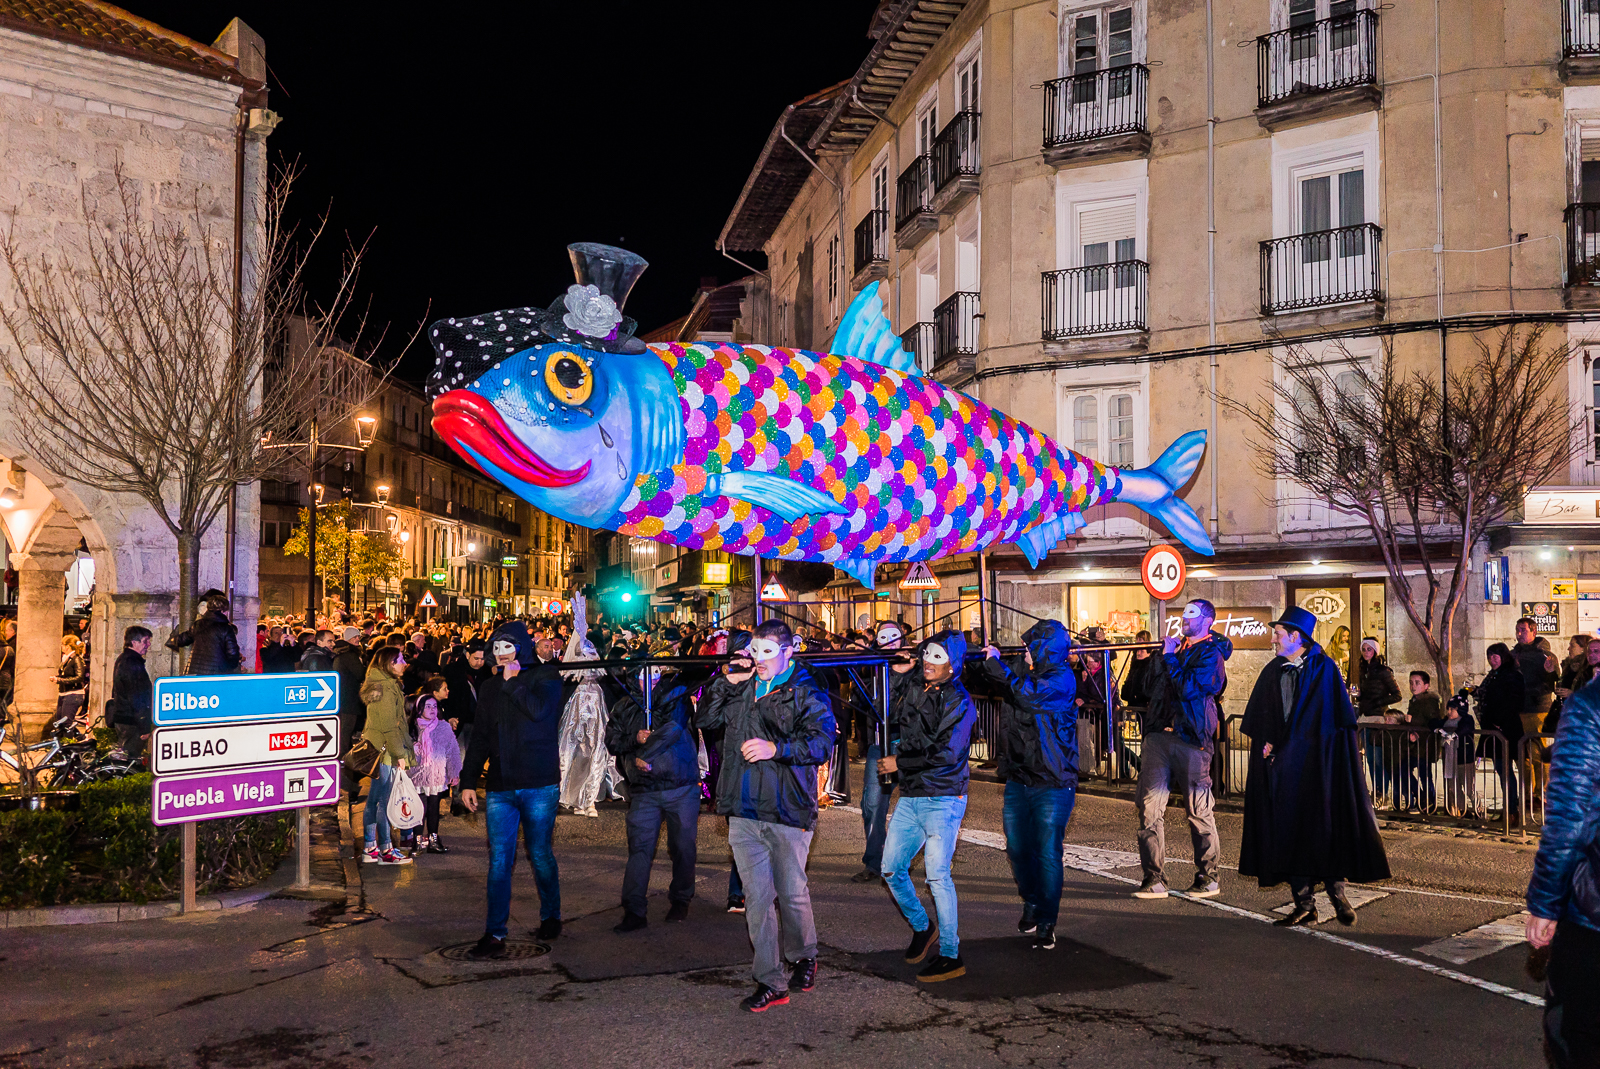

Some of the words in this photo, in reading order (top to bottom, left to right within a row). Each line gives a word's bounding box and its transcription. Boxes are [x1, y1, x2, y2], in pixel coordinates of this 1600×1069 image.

[1152, 563, 1177, 581] 40
[1308, 597, 1338, 614] -50%
[161, 693, 220, 711] Bilbao
[287, 689, 306, 702] A-8
[161, 739, 228, 760] BILBAO
[271, 734, 306, 749] N-634
[160, 787, 225, 810] Puebla
[232, 781, 275, 802] Vieja
